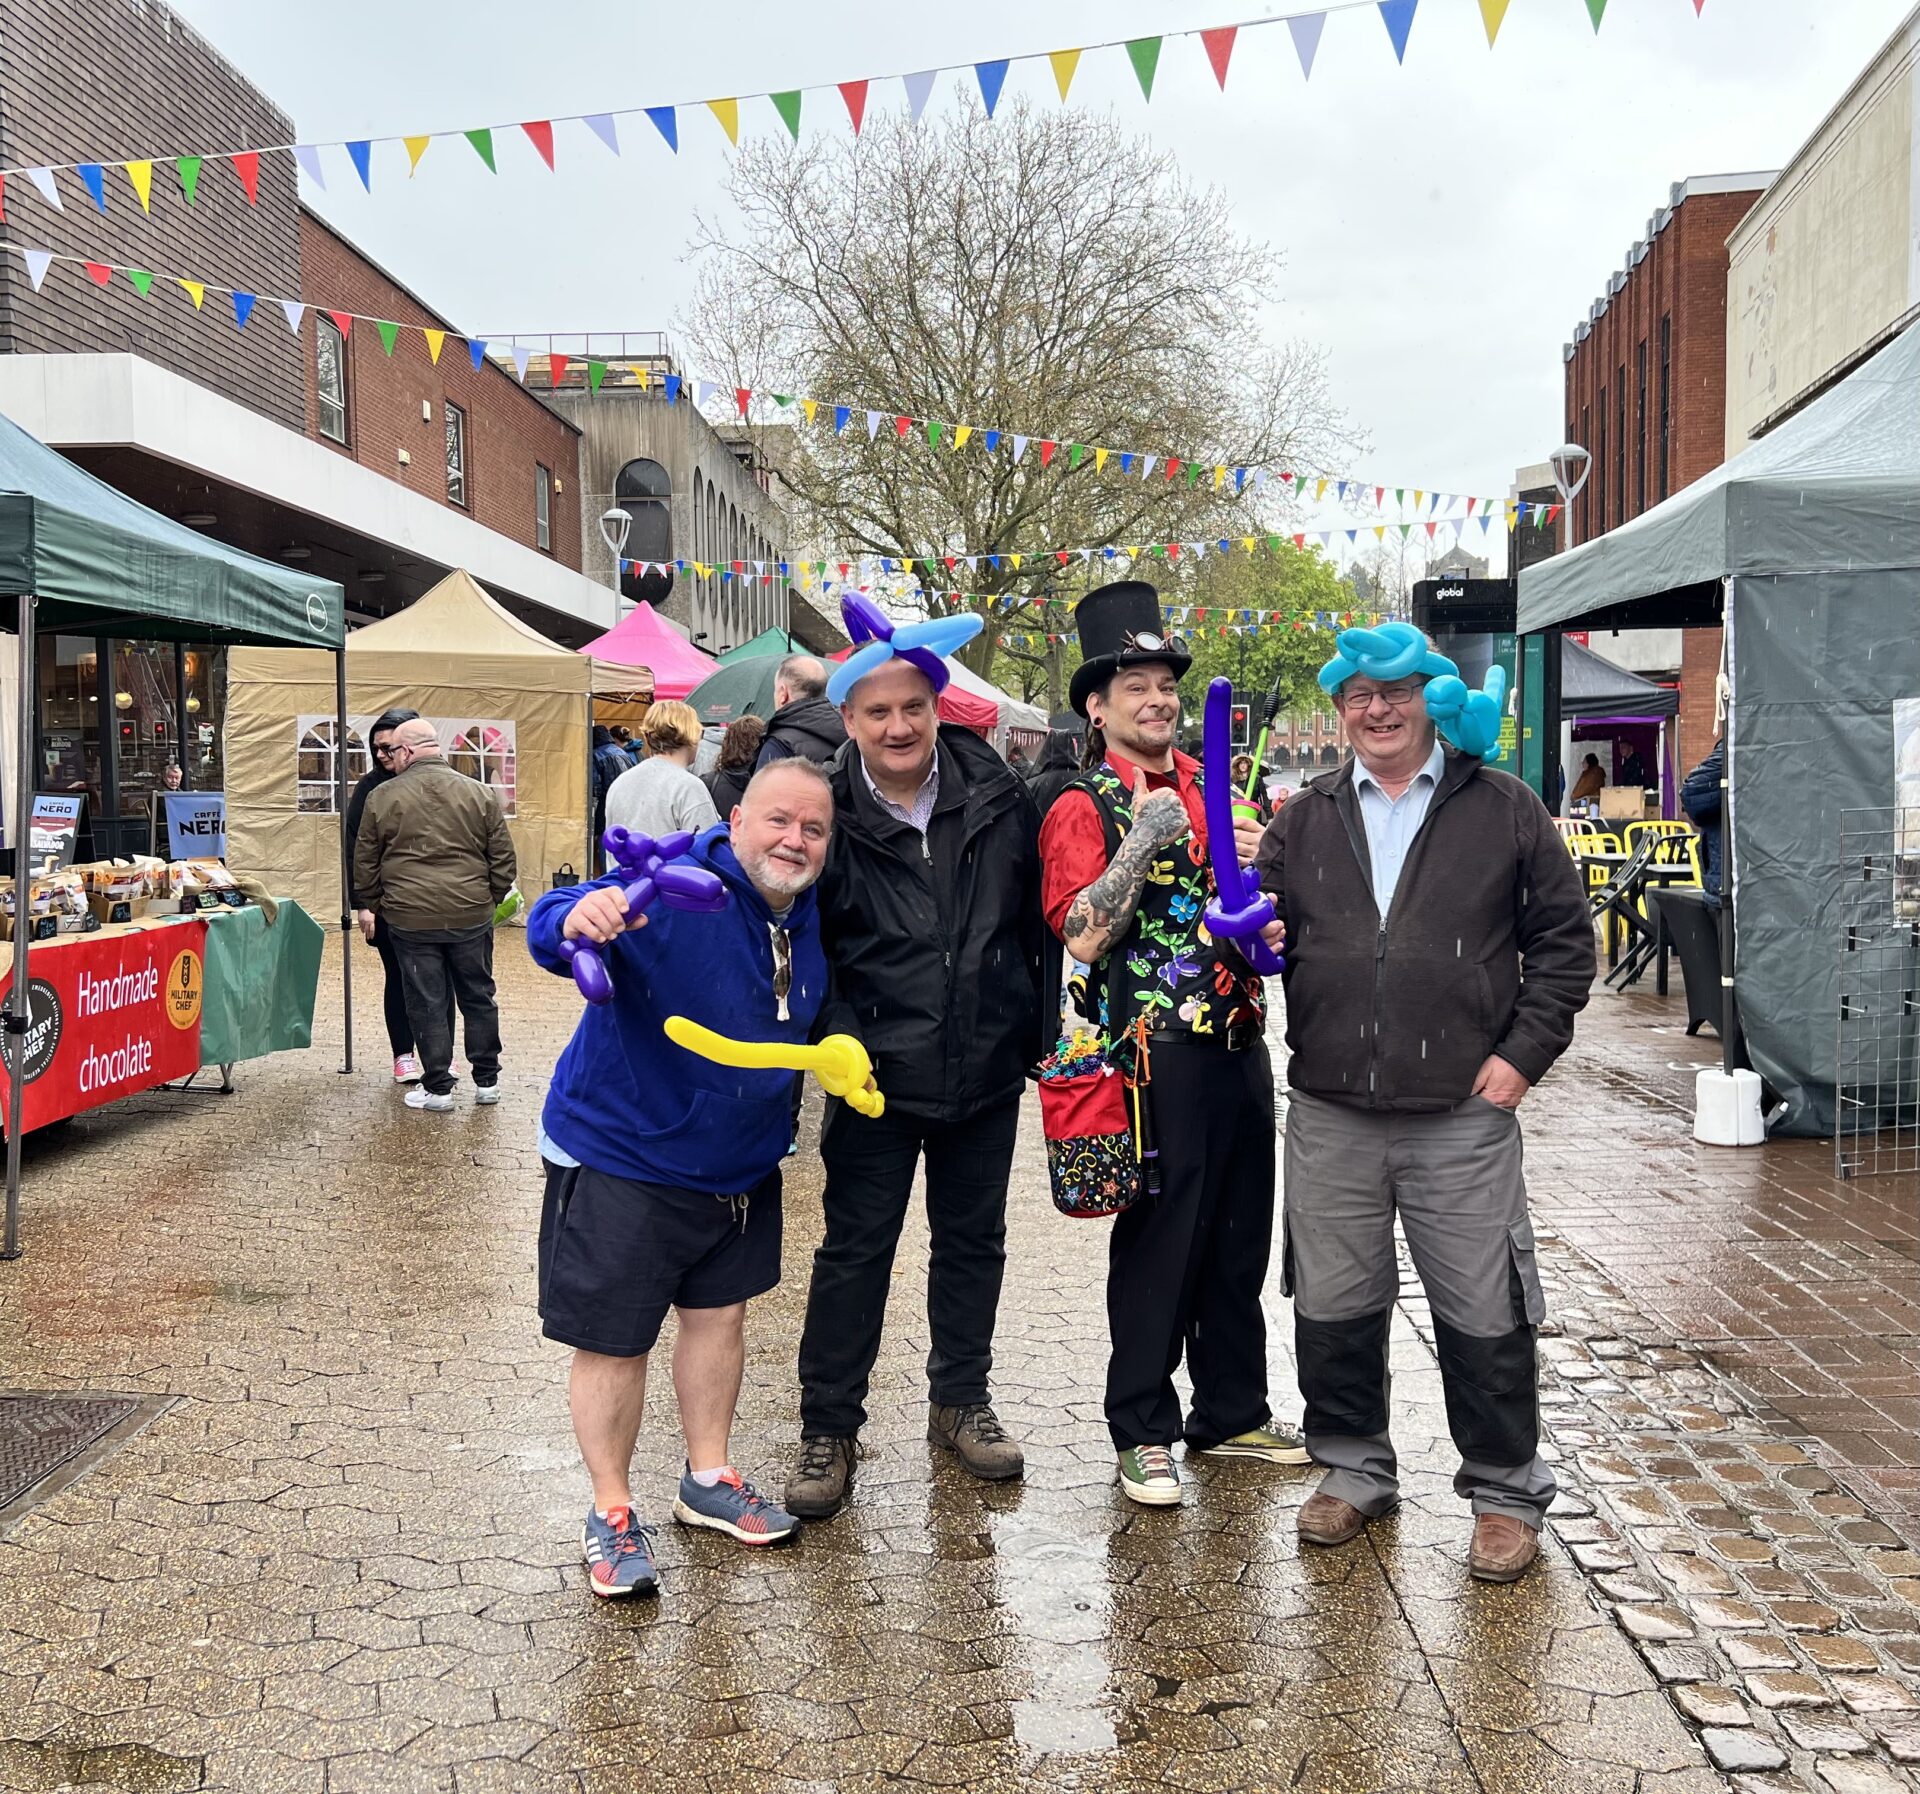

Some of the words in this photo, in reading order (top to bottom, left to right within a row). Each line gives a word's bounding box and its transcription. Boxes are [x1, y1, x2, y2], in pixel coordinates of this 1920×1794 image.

[1436, 587, 1464, 600] global
[39, 805, 73, 814] NERO
[78, 956, 158, 1017] Handmade
[171, 990, 198, 1000] MILITARY
[175, 1001, 192, 1011] CHEF
[79, 1033, 152, 1093] chocolate
